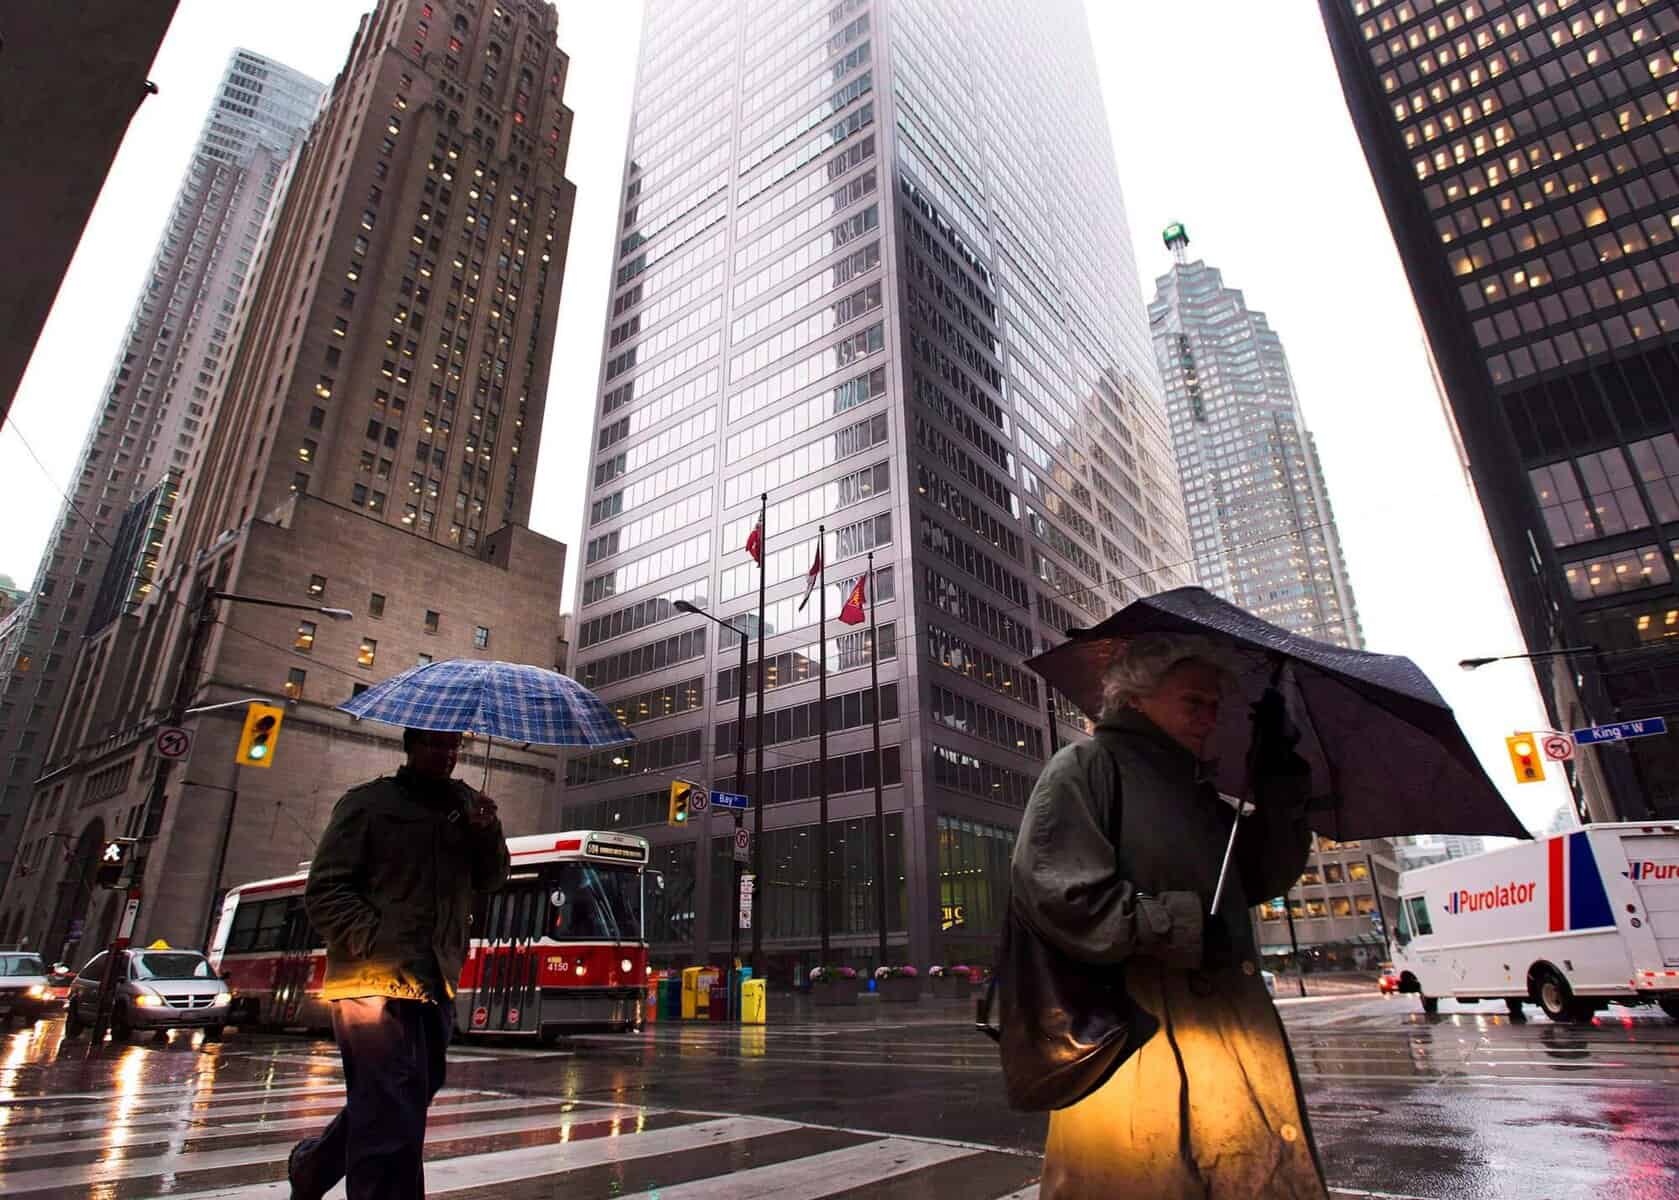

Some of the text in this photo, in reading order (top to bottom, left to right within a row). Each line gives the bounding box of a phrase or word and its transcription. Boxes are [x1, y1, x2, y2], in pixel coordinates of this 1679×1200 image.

[1592, 727, 1621, 739] King
[1631, 722, 1644, 733] W
[719, 793, 733, 807] Bay
[1641, 861, 1679, 880] Pur
[1459, 880, 1536, 914] Purolator
[547, 962, 569, 972] 4150
